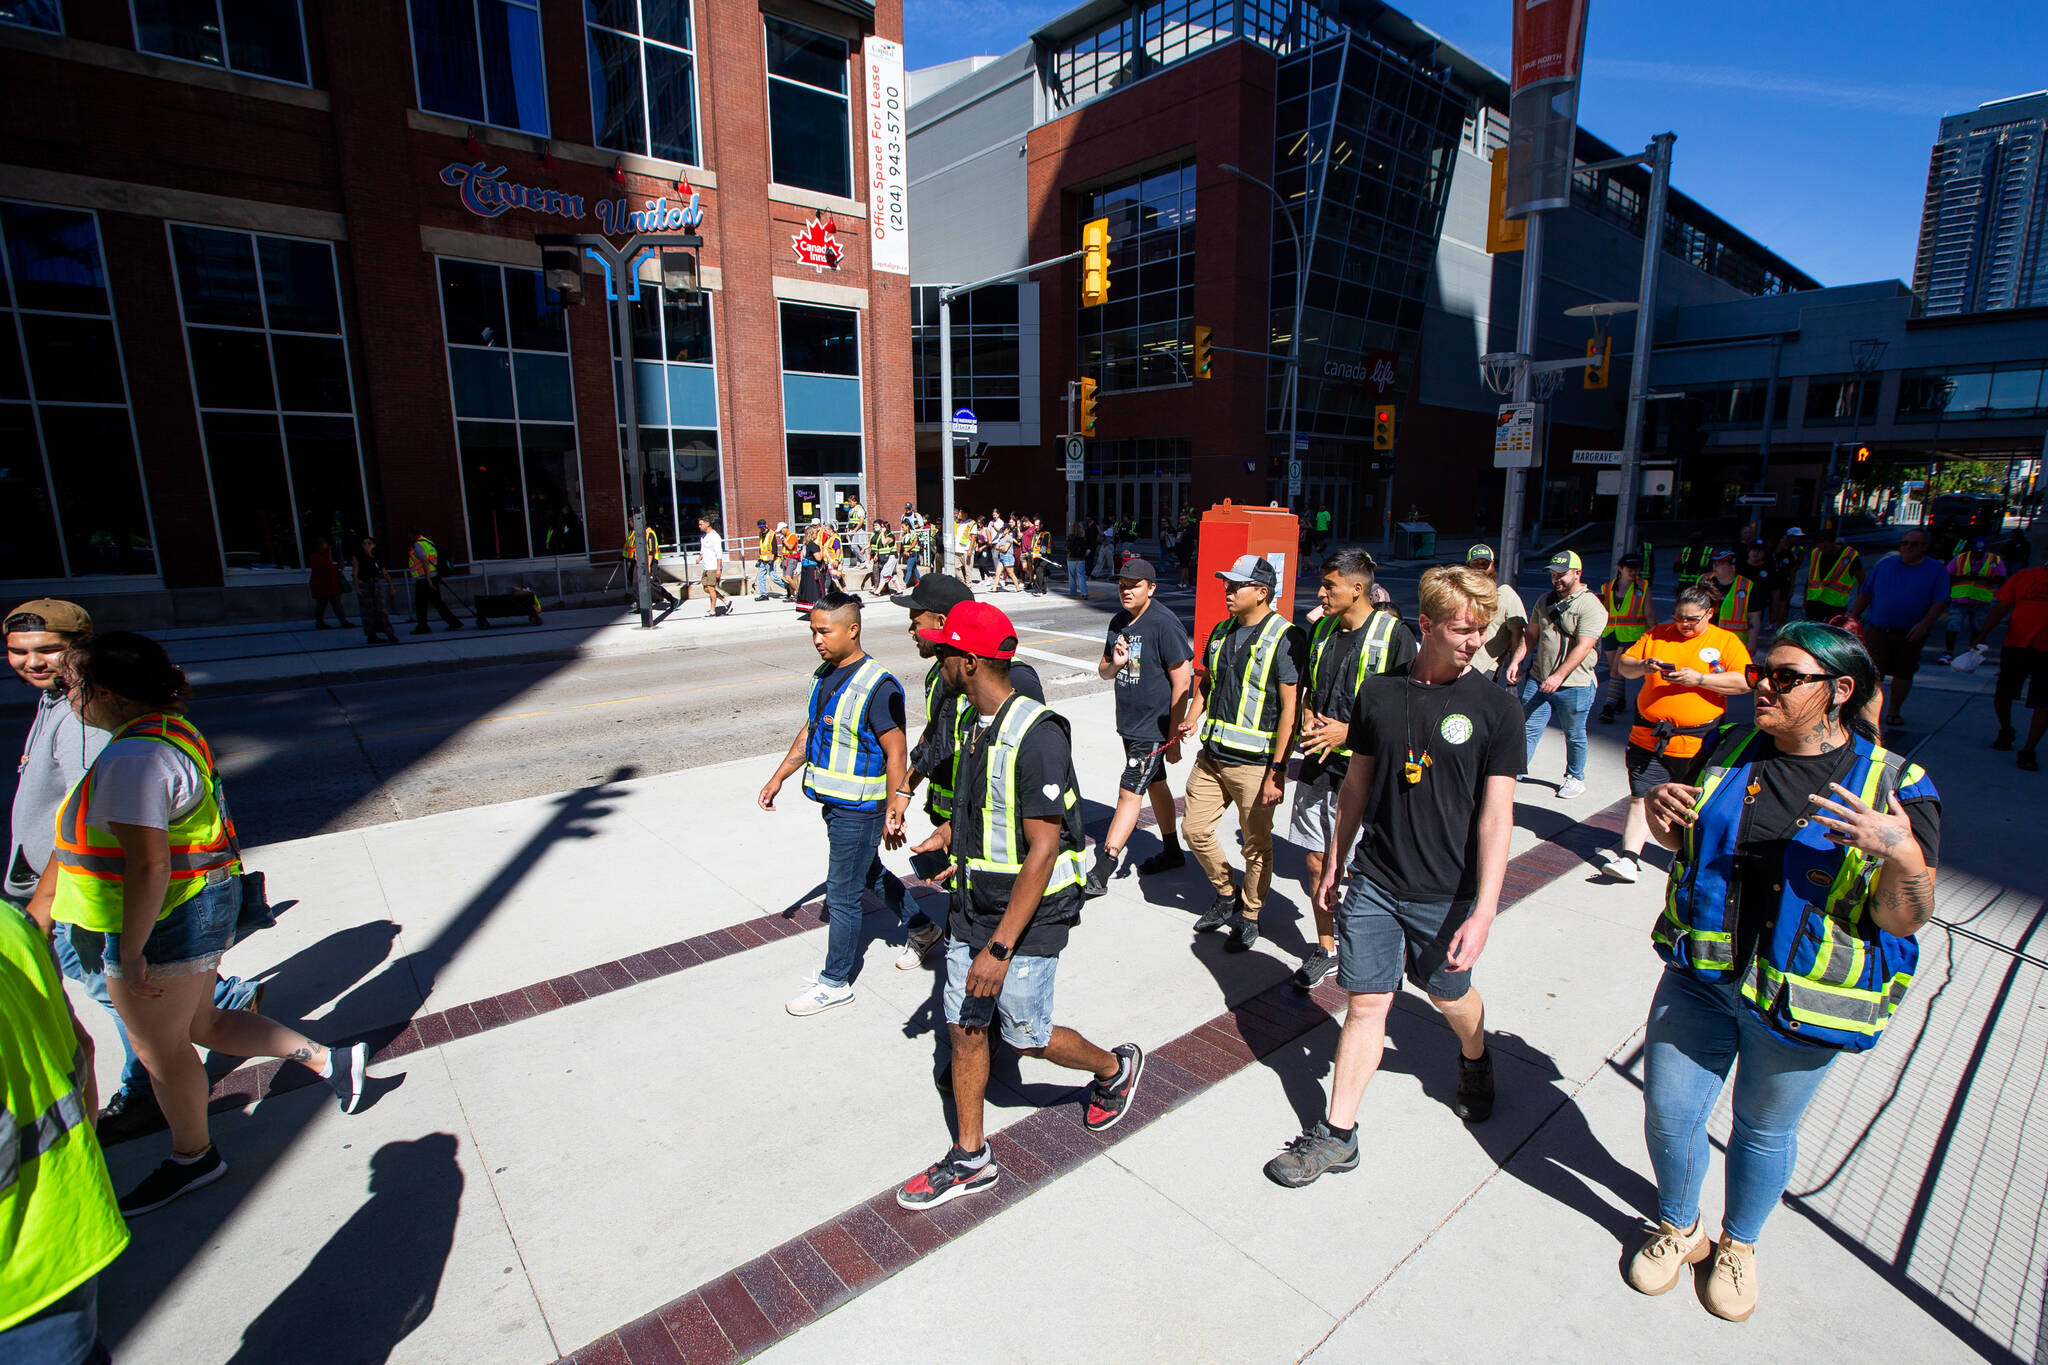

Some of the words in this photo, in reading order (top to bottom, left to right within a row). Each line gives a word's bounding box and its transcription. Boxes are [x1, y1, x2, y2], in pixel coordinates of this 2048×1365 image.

[871, 64, 881, 108] Lease
[872, 113, 882, 140] For
[886, 86, 901, 176] 943-5700
[873, 145, 886, 190] Space
[439, 161, 586, 220] Tavern
[595, 193, 704, 235] United
[873, 195, 885, 240] Office
[889, 185, 904, 232] (204)
[1323, 360, 1367, 380] canada
[1369, 359, 1396, 393] life
[1575, 451, 1612, 462] HARGRAVE
